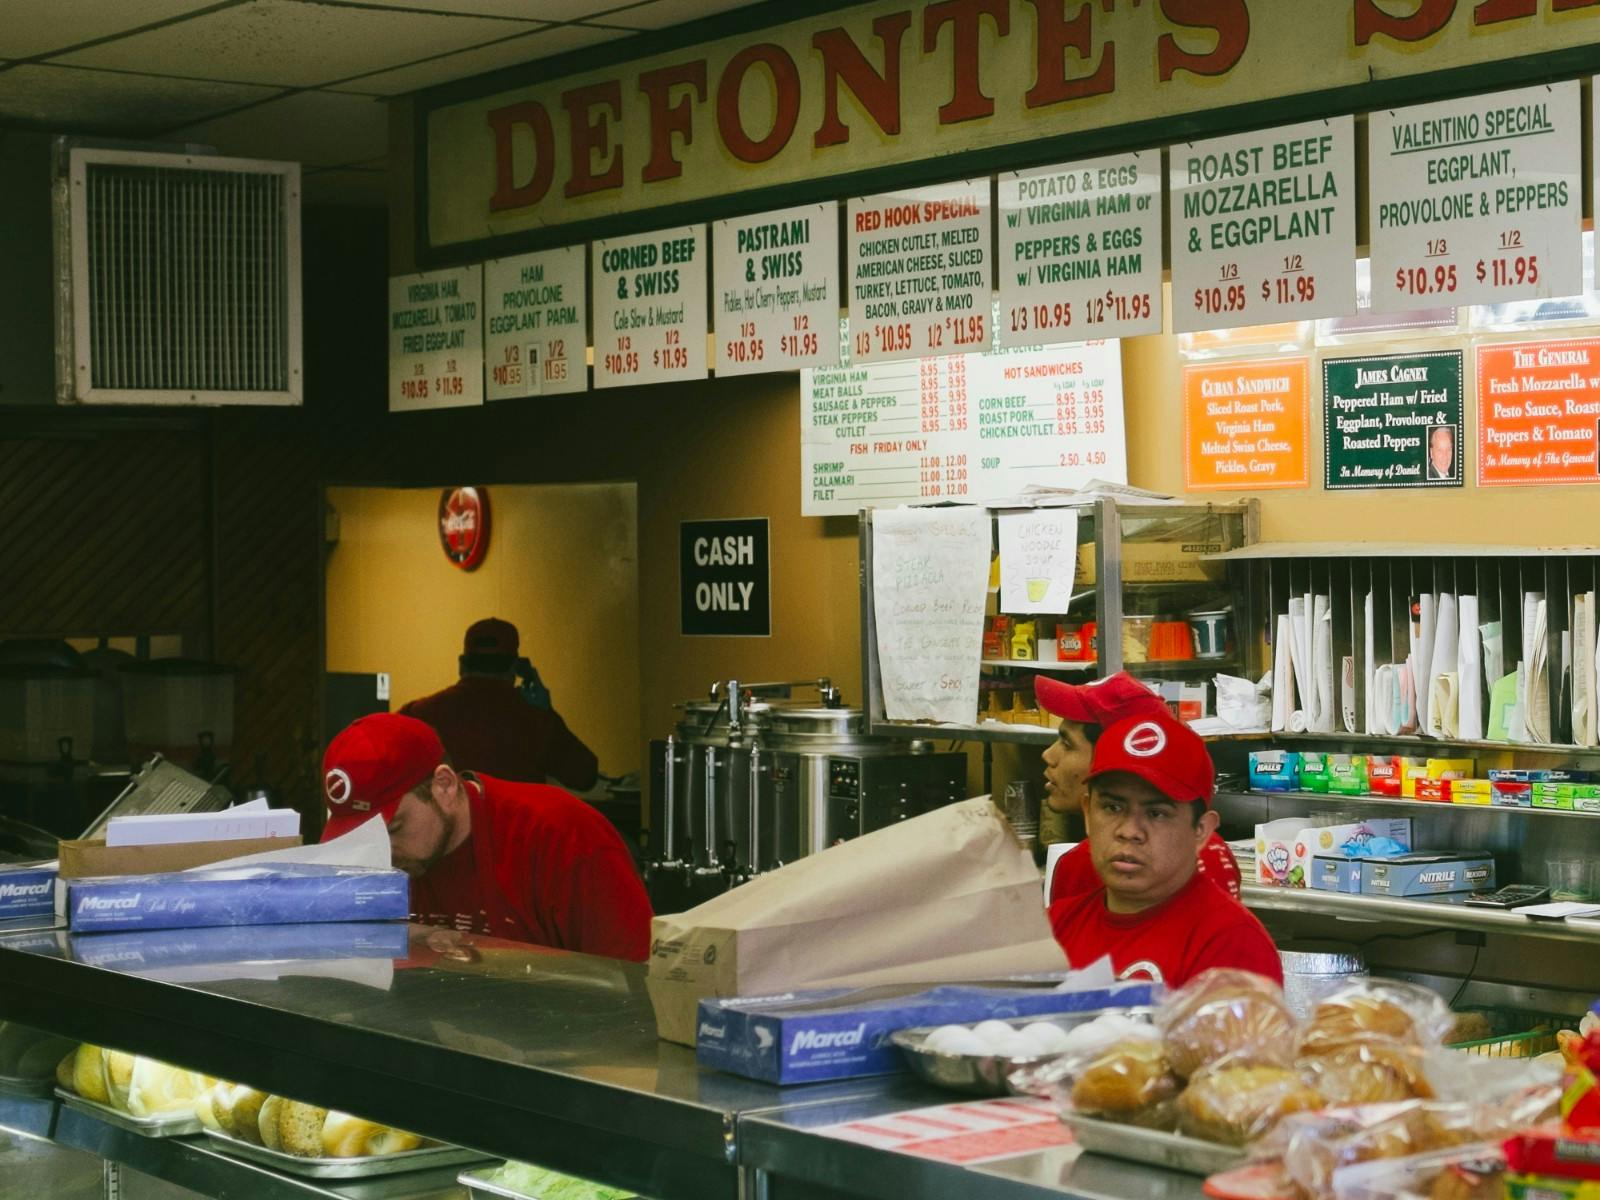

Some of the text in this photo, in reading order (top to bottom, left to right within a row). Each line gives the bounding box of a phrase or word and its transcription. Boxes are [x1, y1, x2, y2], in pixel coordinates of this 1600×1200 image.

[486, 0, 1250, 213] DEFONTES
[1392, 104, 1552, 150] VALENTINO SPECIAL
[1187, 135, 1333, 184] ROAST BEEF
[1428, 150, 1516, 185] EGGPLANT,
[1184, 171, 1337, 218] MOZZARELLA
[1380, 182, 1568, 228] PROVOLONE & PEPPERS
[856, 197, 980, 233] RED HOOK SPECIAL
[738, 219, 809, 253] PASTRAMI
[1188, 207, 1335, 253] & EGGPLANT
[602, 238, 695, 272] CORNED BEEF
[1015, 227, 1142, 261] PEPPERS & EGGS
[521, 265, 543, 283] HAM
[746, 251, 802, 282] & SWISS
[1017, 254, 1142, 287] w/ VIRGINIA HAM
[618, 270, 679, 299] & SWISS
[855, 272, 984, 300] TURKEY, LETTUCE, TOMATO,
[504, 285, 562, 309] PROVOLONE
[866, 294, 973, 320] BACON, GRAVY & MAYO
[490, 307, 579, 335] EGGPLANT PARM.
[614, 303, 683, 330] Cole Slaw & Mustard
[426, 330, 465, 351] EGGPLANT
[1513, 348, 1589, 368] THE GENERAL
[813, 371, 868, 386] VIRGINIA HAM
[1004, 362, 1083, 379] HOT SANDWICHES
[1355, 366, 1428, 388] JAMES CAGNEY
[813, 385, 863, 399] MEAT BALLS
[1201, 377, 1289, 397] CUBAN SANDWICH
[979, 410, 1034, 424] ROAST PORK
[980, 424, 1054, 439] CHICKEN CUTLET
[1343, 434, 1420, 450] Roasted Peppers
[1487, 427, 1592, 445] Peppers & Tomato
[850, 440, 927, 455] FISH FRIDAY ONLY
[813, 462, 845, 474] SHRIMP
[981, 457, 1001, 469] SOUP
[1216, 459, 1276, 474] Pickles, Gravy
[694, 536, 754, 566] CASH
[695, 582, 754, 611] ONLY
[1257, 762, 1282, 773] HALLS
[1373, 766, 1393, 777] HALLS
[1420, 871, 1456, 883] NITRILE
[77, 893, 141, 913] Marcal
